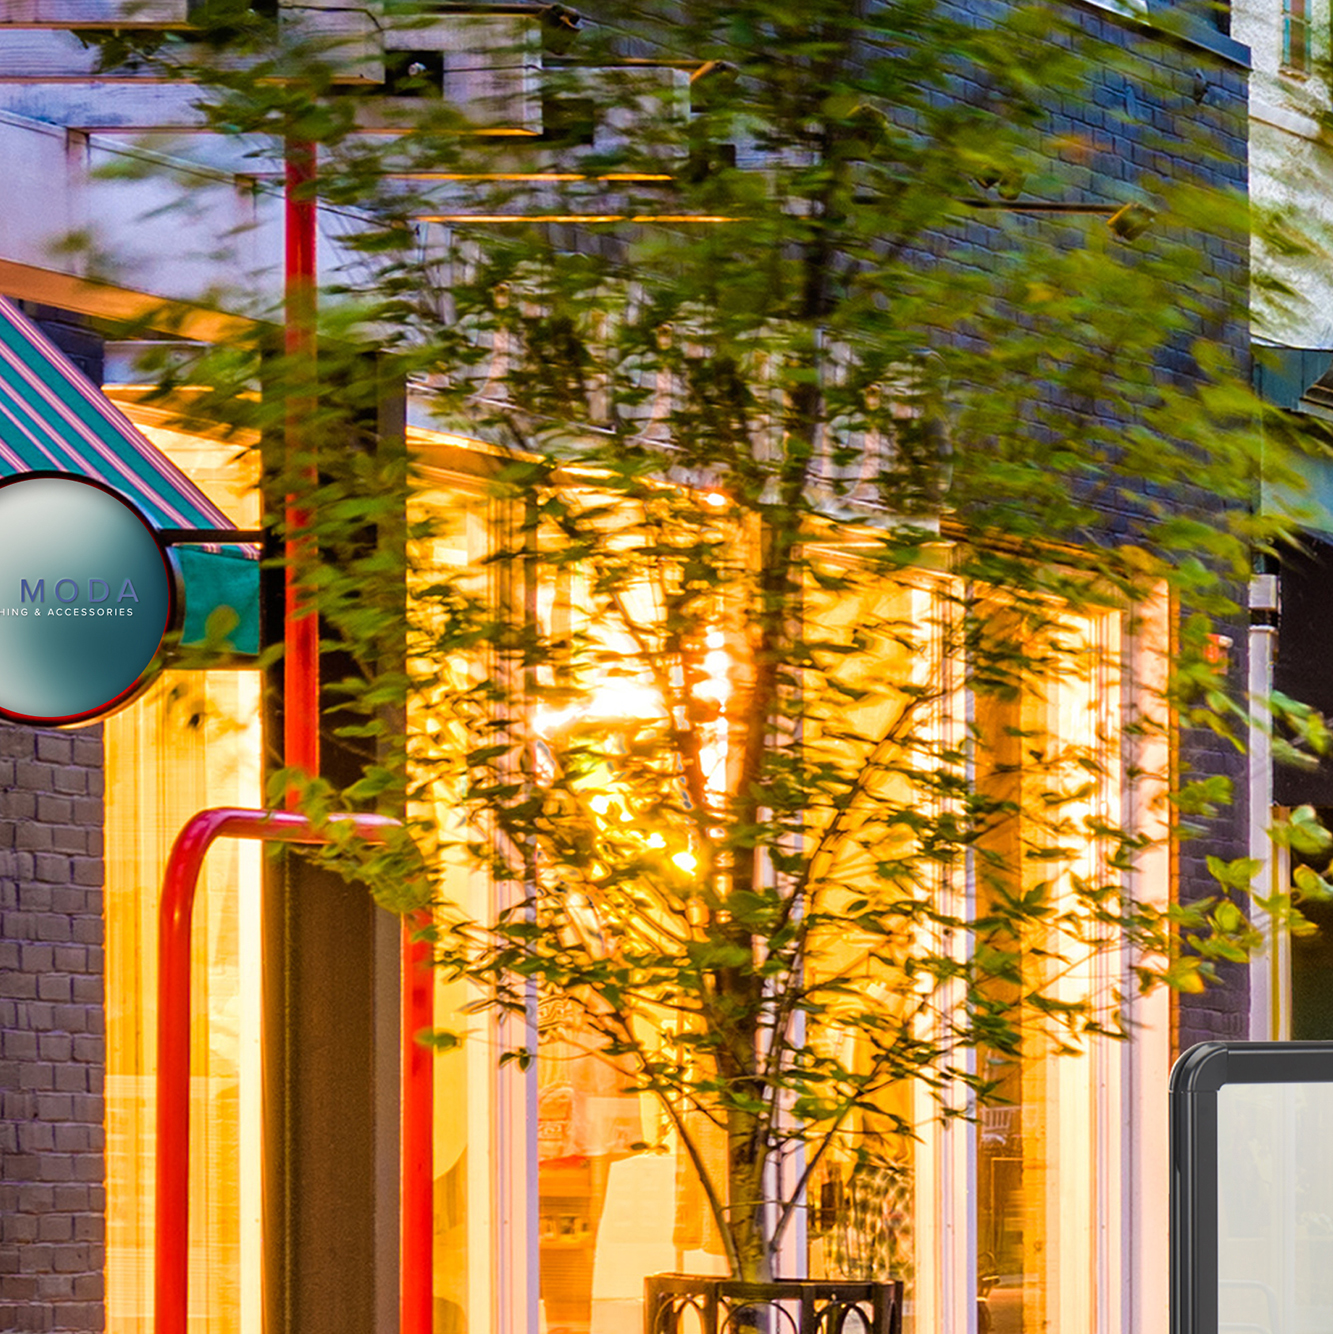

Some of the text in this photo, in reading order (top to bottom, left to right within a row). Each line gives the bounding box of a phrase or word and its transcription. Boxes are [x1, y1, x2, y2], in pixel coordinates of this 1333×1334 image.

[20, 578, 139, 603] MODA
[34, 608, 42, 617] &
[47, 608, 134, 617] ACCESSORIES
